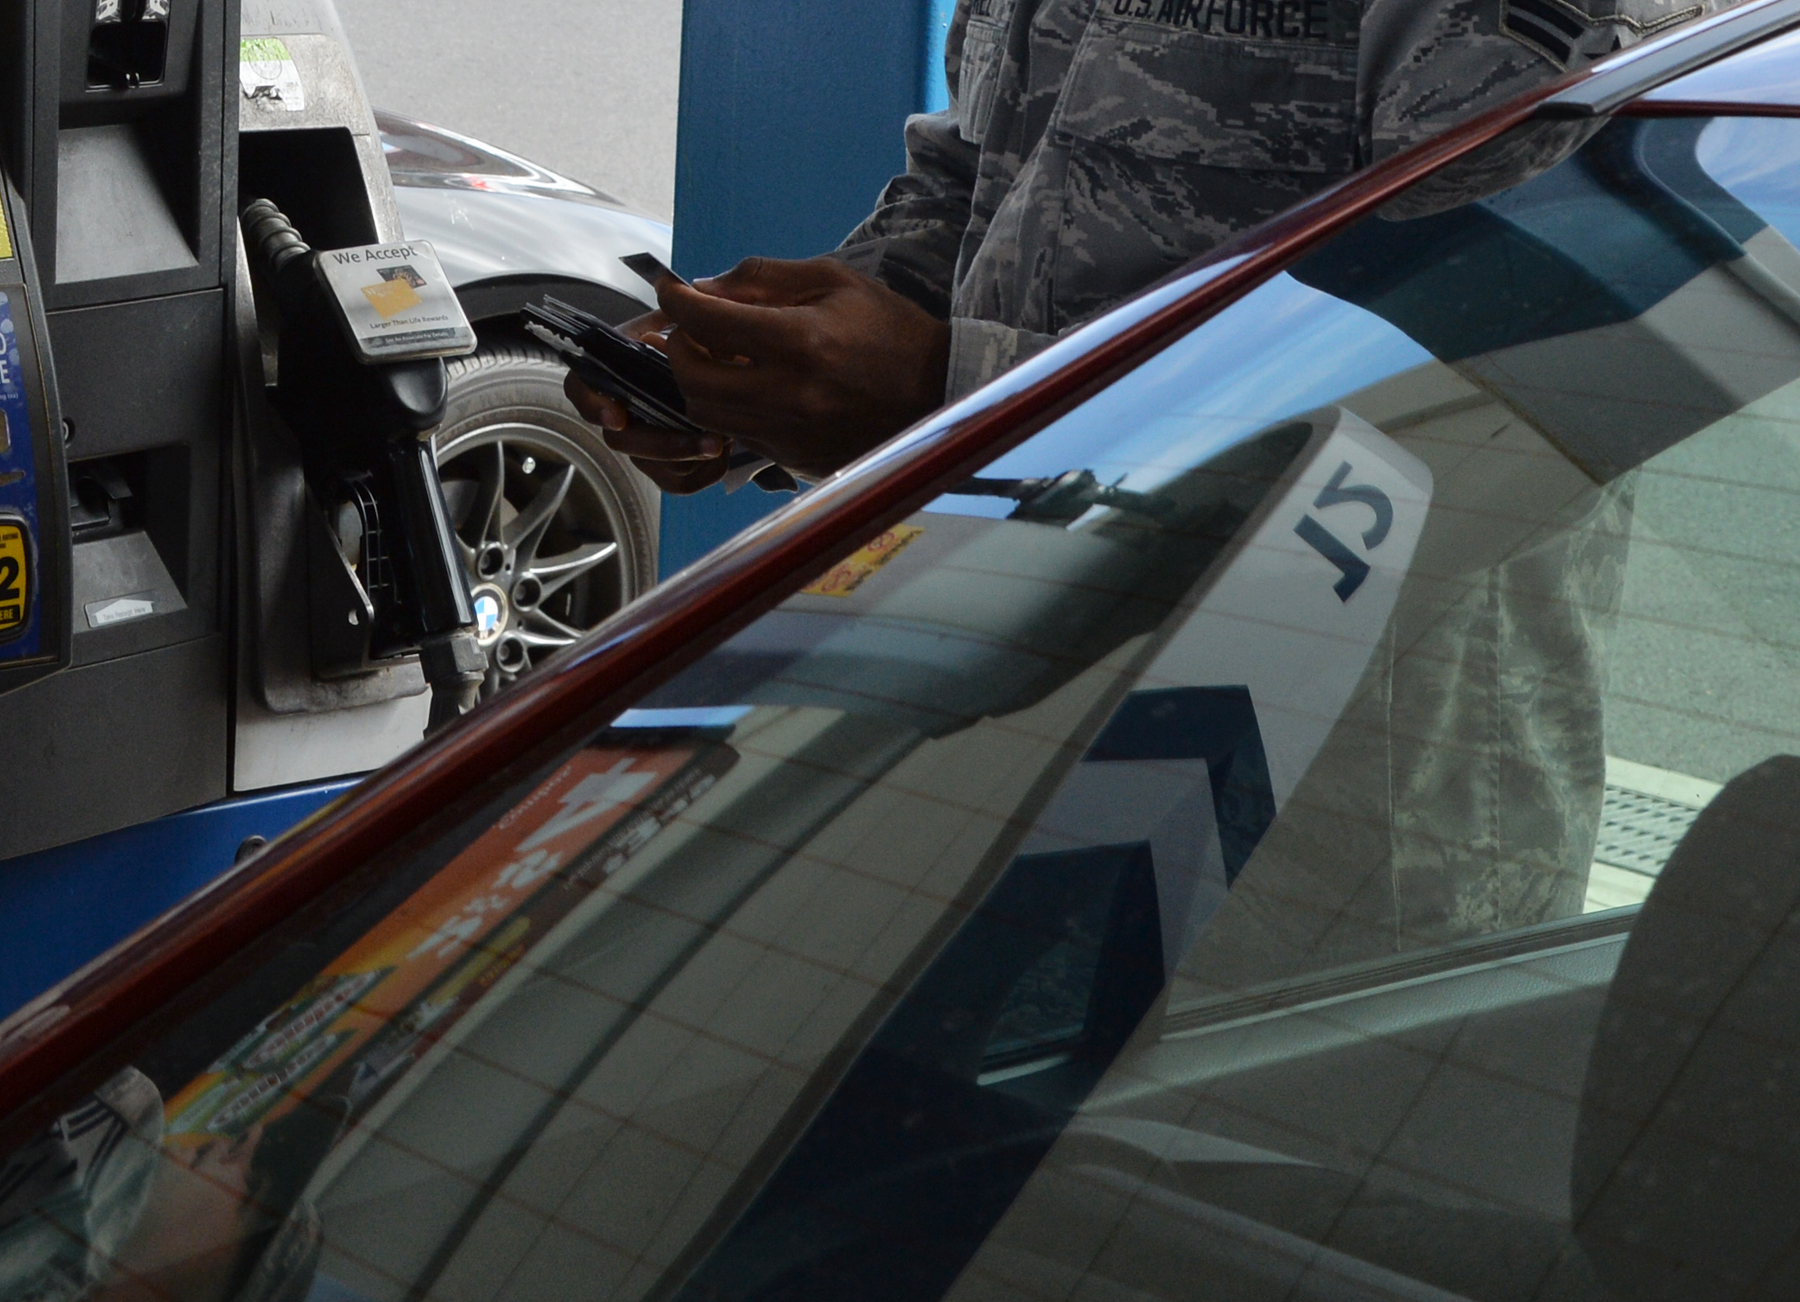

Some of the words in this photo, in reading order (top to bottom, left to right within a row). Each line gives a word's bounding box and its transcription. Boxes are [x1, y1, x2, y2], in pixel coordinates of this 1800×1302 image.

[332, 251, 362, 265] We
[365, 245, 418, 261] Accept
[369, 320, 391, 331] Larger
[392, 318, 408, 327] Than
[409, 317, 422, 325] Life
[422, 314, 449, 323] Rewards
